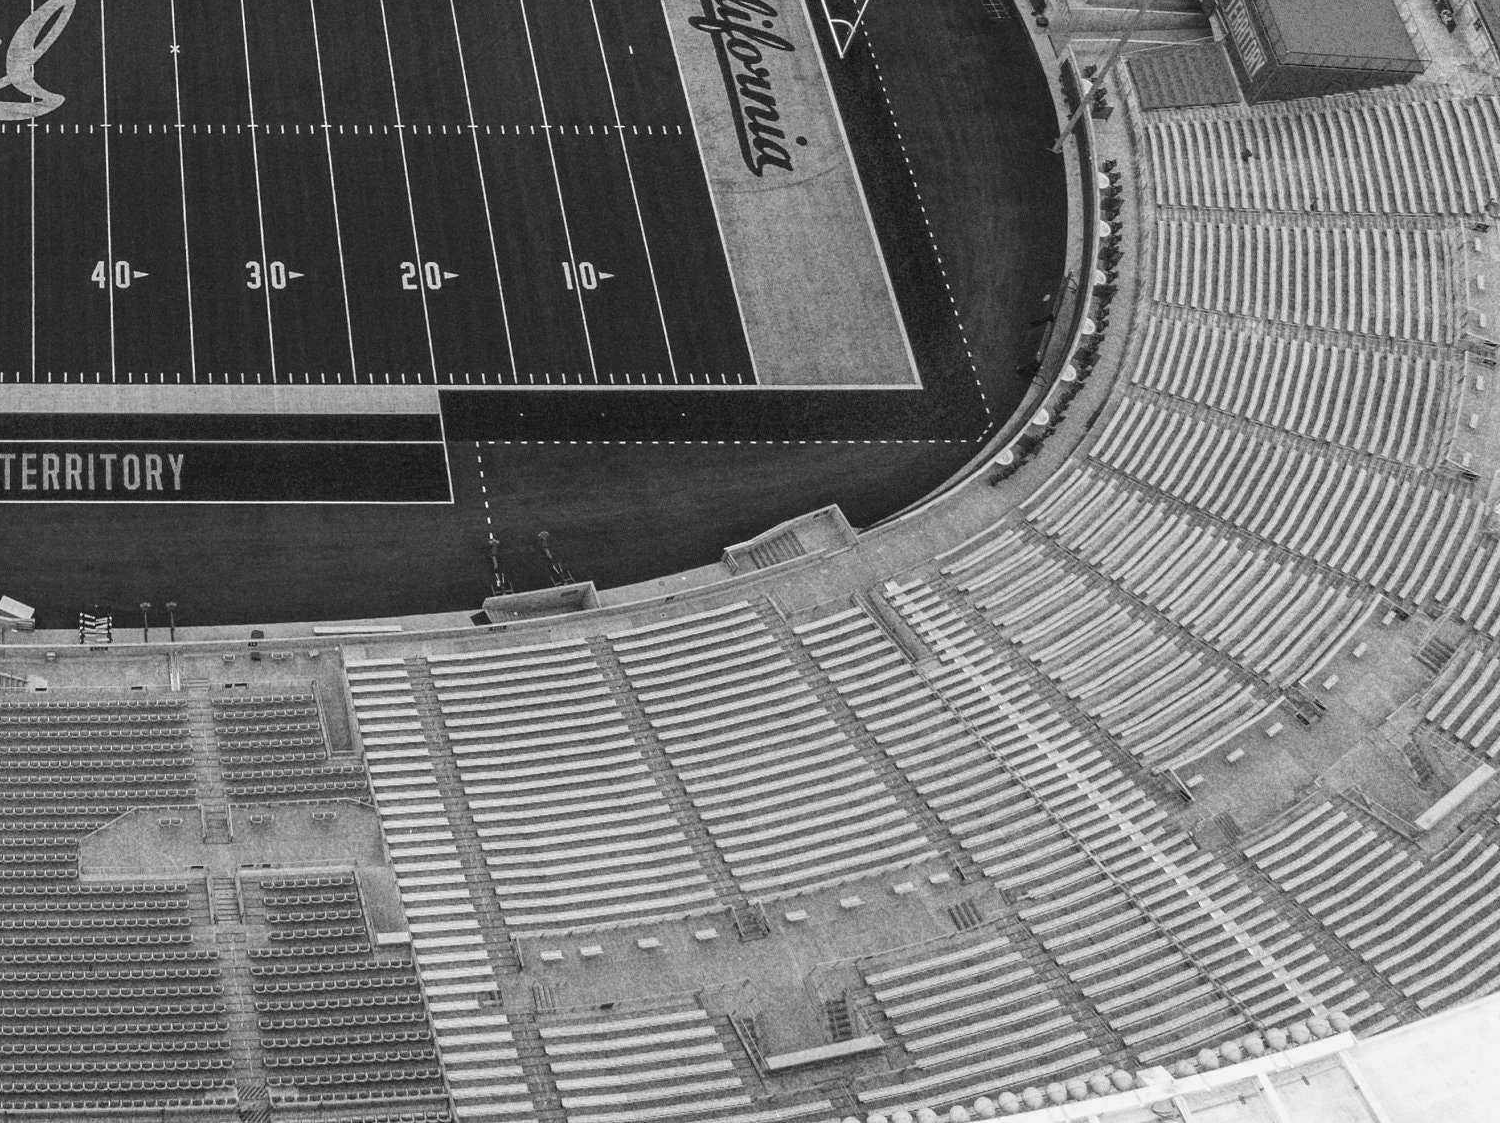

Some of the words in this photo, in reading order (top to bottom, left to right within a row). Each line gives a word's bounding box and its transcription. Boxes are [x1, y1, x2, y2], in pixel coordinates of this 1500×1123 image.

[91, 261, 131, 289] 40
[246, 261, 287, 289] 30
[401, 261, 442, 290] 20
[562, 262, 597, 290] 10
[0, 453, 184, 490] TERRITORY
